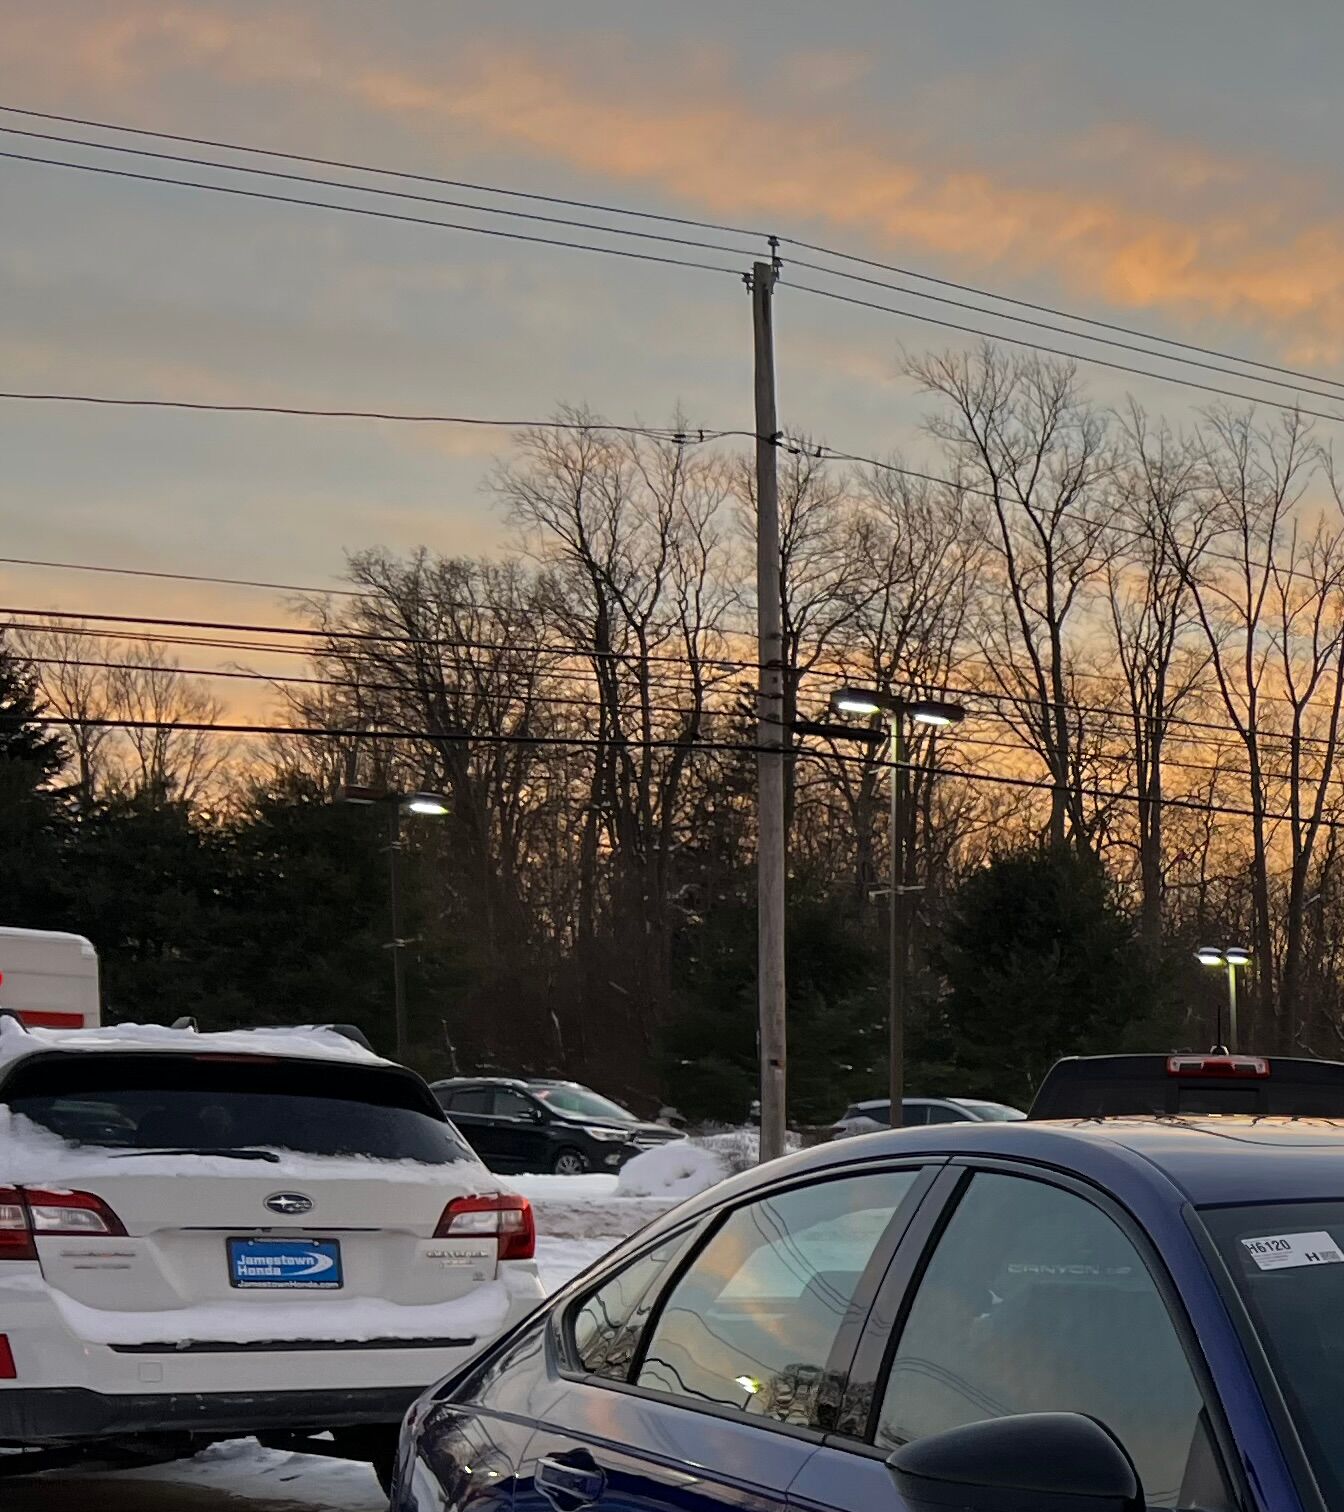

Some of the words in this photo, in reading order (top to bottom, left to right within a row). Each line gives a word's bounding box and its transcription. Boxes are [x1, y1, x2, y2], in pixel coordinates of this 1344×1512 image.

[1244, 1239, 1291, 1255] H6120
[237, 1254, 315, 1265] Jamestown
[237, 1265, 282, 1276] Honda
